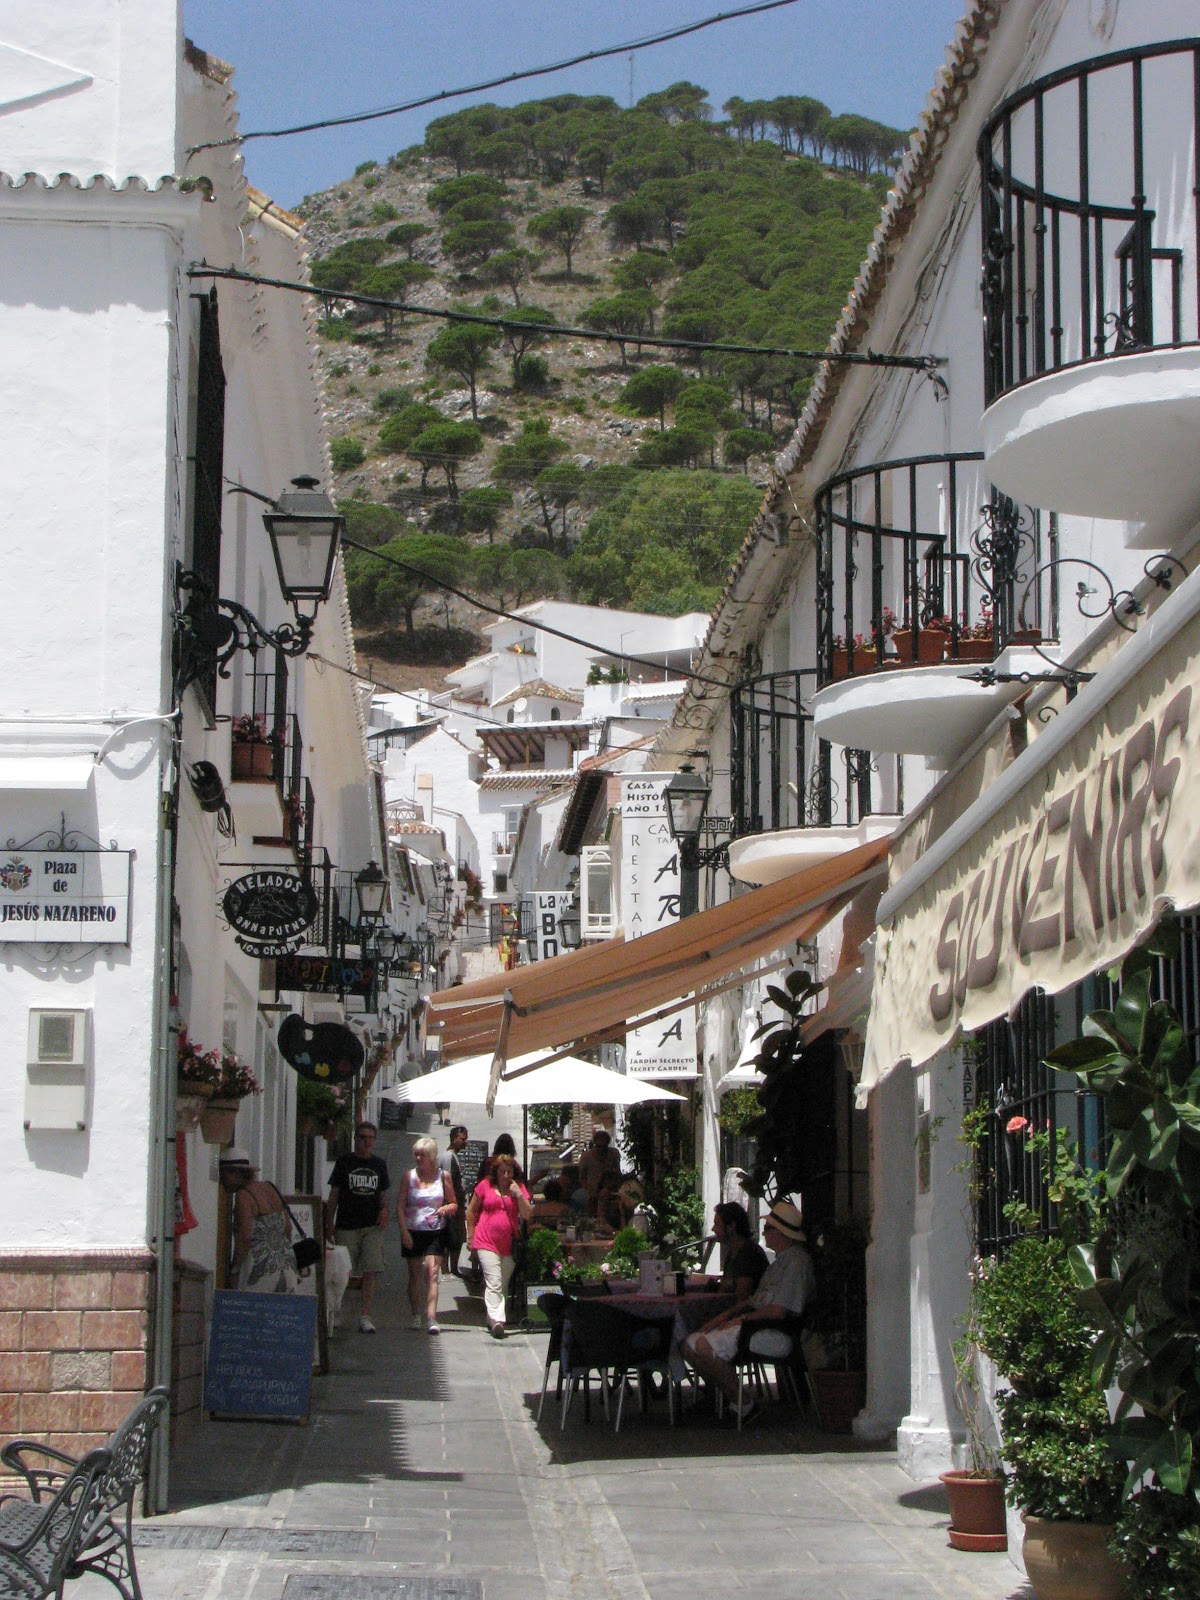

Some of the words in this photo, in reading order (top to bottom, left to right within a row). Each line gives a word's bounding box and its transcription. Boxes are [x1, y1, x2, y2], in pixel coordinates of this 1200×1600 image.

[627, 782, 654, 790] CASA
[626, 804, 650, 813] AÑO
[930, 685, 1192, 1021] SOUVENIRS
[44, 860, 77, 875] Plaza
[53, 879, 68, 892] de
[235, 874, 303, 894] HELADOS
[1, 902, 40, 922] JESÚS
[43, 904, 117, 922] NAZARENO
[348, 1173, 379, 1190] EVERLAST
